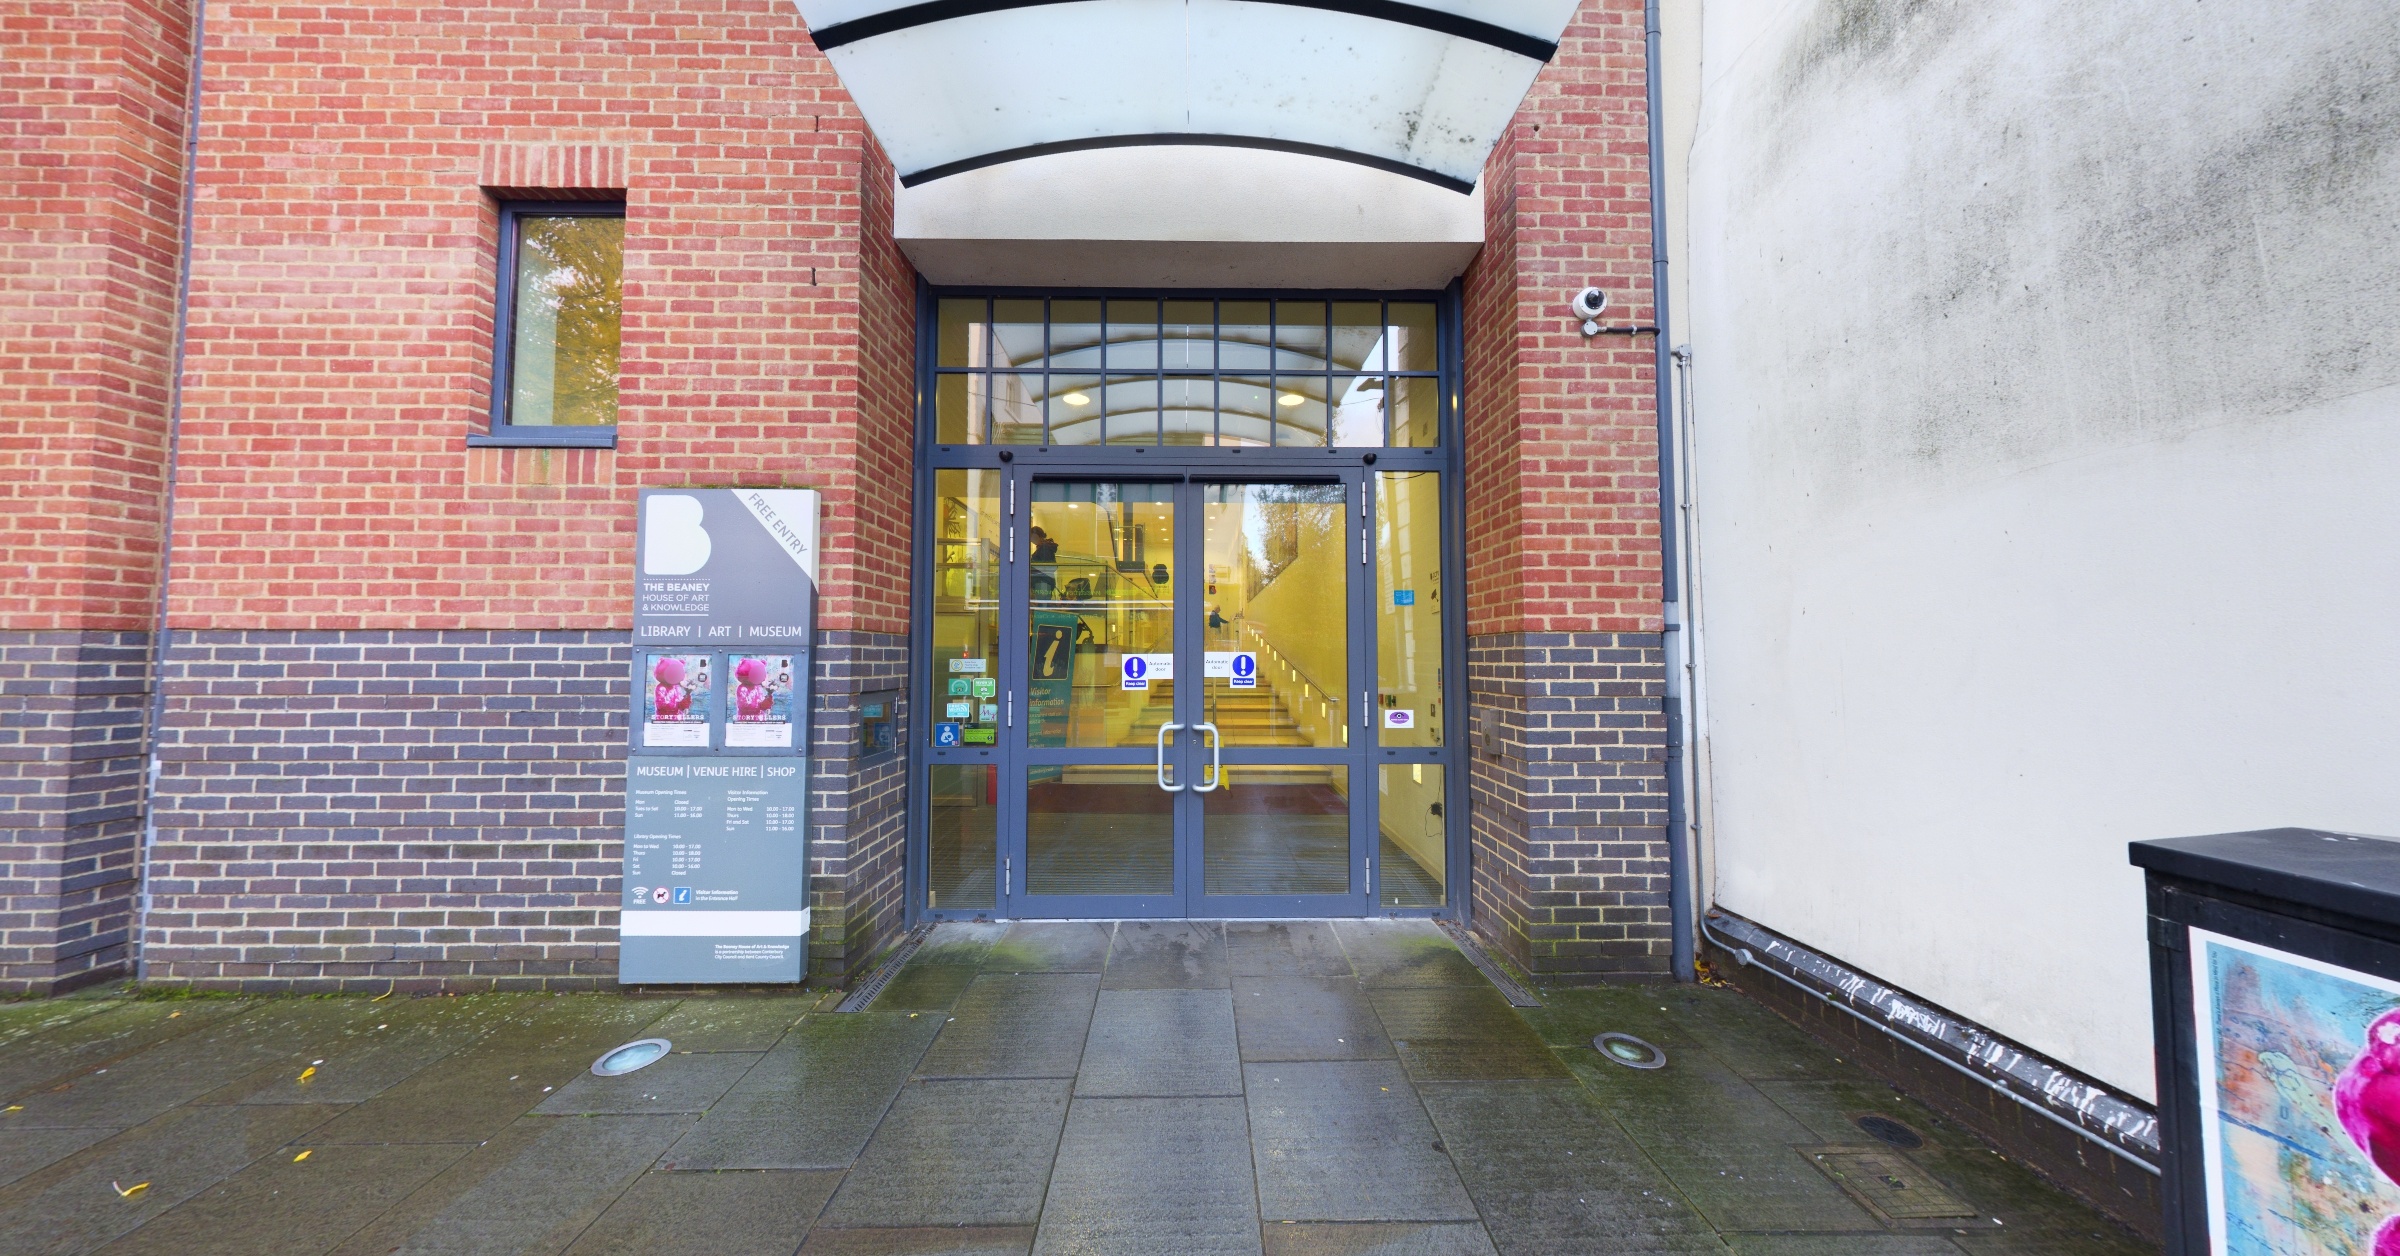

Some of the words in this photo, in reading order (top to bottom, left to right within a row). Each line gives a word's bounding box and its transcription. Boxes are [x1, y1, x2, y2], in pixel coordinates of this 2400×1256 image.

[748, 492, 776, 522] FREE
[772, 520, 808, 555] ENTRY
[644, 494, 712, 575] B
[644, 583, 664, 592] THE
[667, 583, 710, 592] BEANEY
[641, 626, 691, 636] LIBRARY
[708, 626, 732, 636] ART
[750, 626, 802, 636] MUSEUM
[1030, 687, 1051, 696] Visitor
[1029, 698, 1064, 706] information
[637, 766, 683, 776] MUSEUM
[693, 766, 729, 776] VENUE
[732, 766, 757, 776] HIRE
[767, 766, 796, 776] SHOP
